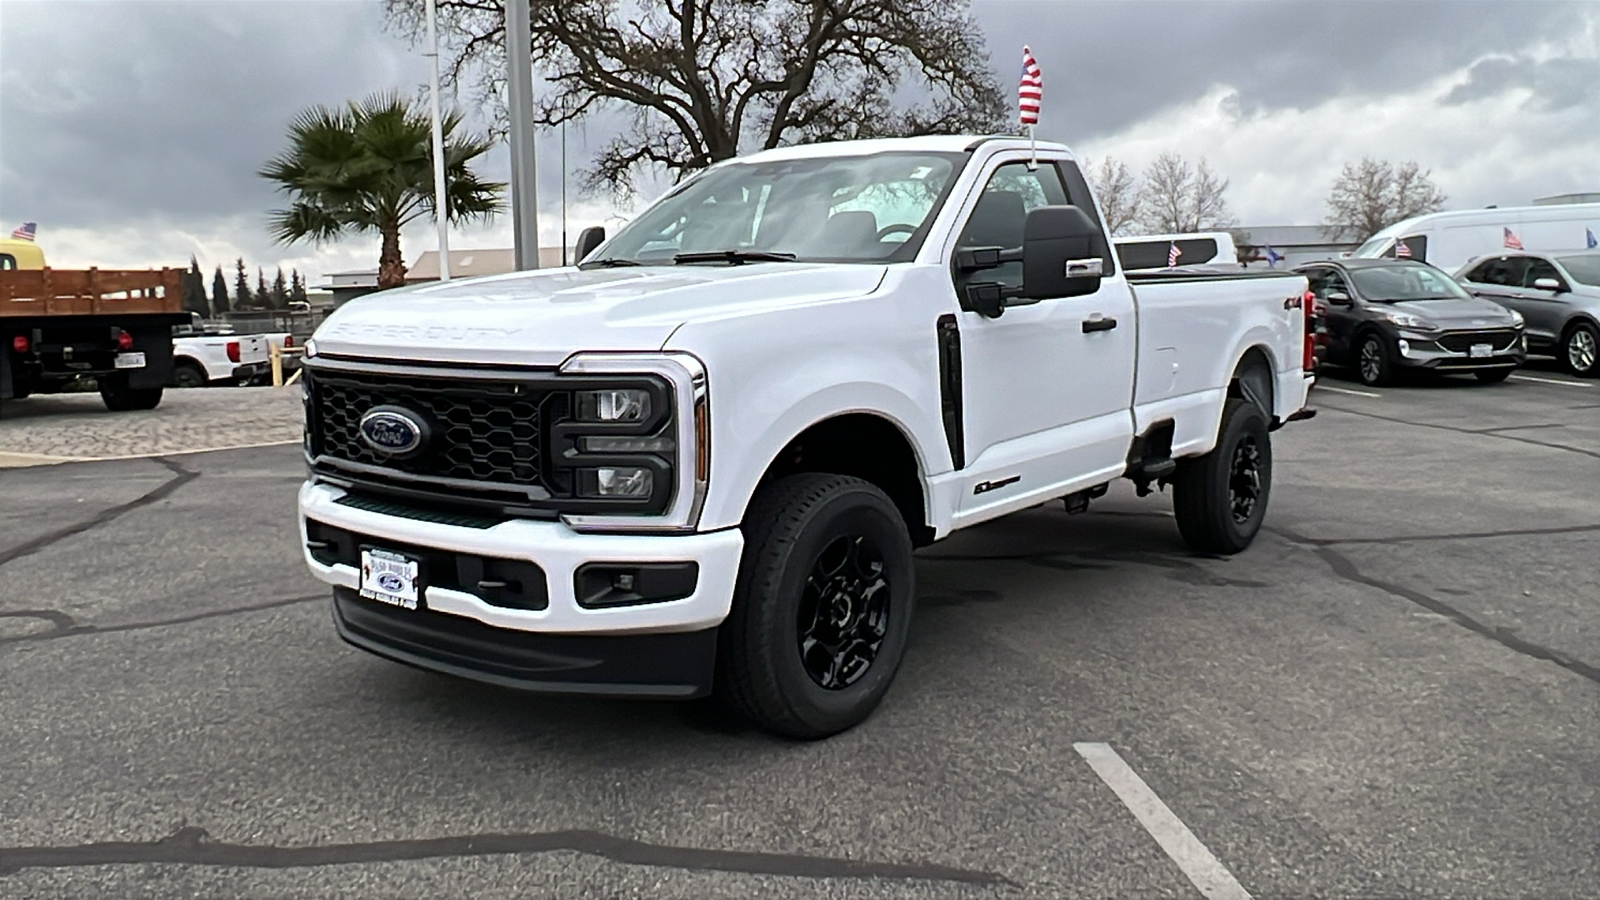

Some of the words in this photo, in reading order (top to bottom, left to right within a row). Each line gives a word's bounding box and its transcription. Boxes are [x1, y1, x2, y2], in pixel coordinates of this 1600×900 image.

[330, 322, 419, 338] SUPER
[425, 326, 522, 341] DUTY
[371, 418, 405, 445] Ford
